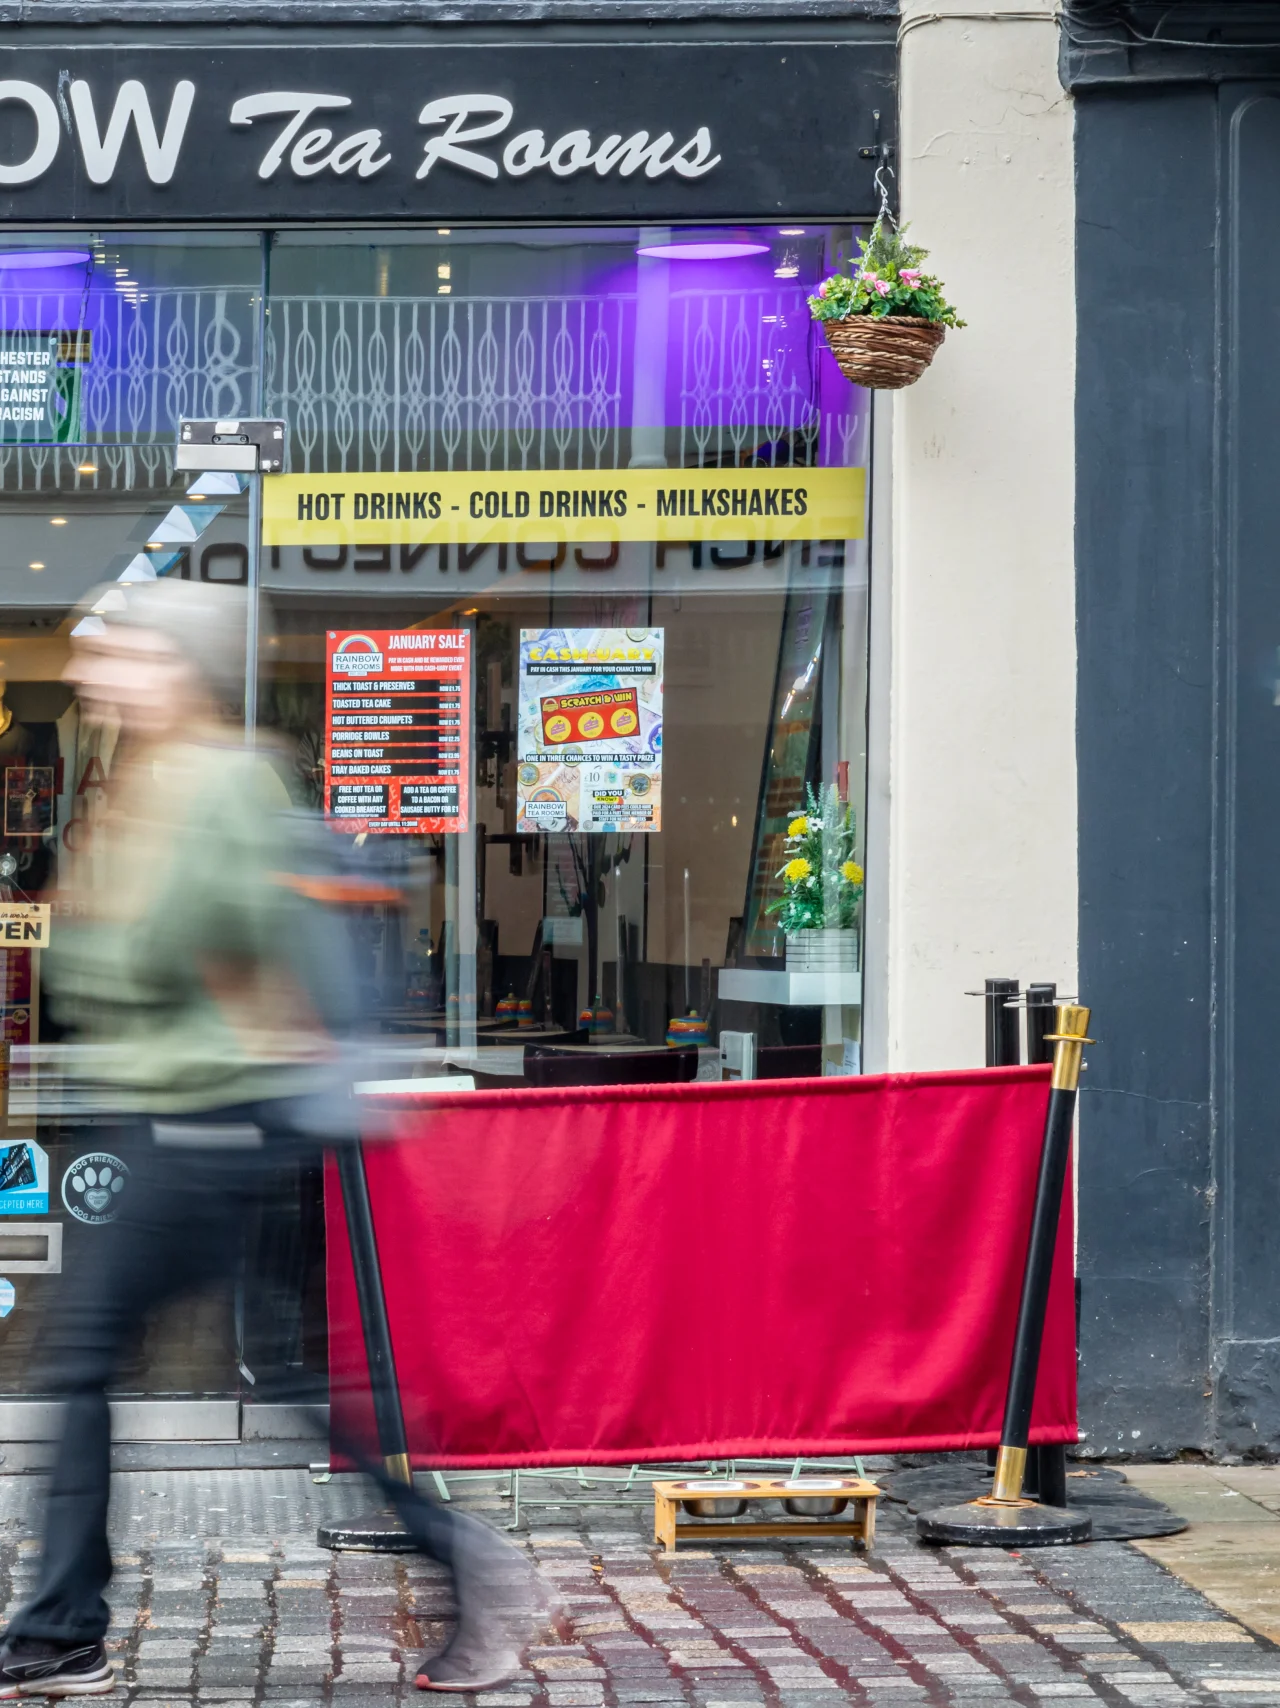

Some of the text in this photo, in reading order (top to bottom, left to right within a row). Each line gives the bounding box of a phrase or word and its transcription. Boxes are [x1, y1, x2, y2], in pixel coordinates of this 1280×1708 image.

[230, 91, 391, 178] Tea
[415, 94, 721, 179] Rooms
[298, 488, 808, 520] HOT DRINKS COLD DRINKS MILKSHAKES
[388, 635, 465, 650] JANUARY SALE
[336, 655, 380, 663] RAINBOW
[528, 648, 655, 661] CASH-UARY
[332, 681, 415, 691] THICK TOAST & PRESERVES
[332, 699, 391, 708] TOASTED TEA CAKE
[560, 692, 633, 708] SCRATCH & WIN
[332, 715, 413, 725] HOT BUTTERED CRUMPETS
[332, 732, 390, 741] PORRIDGE BOWLES
[331, 749, 384, 758] BEANS ON TOAST
[331, 765, 391, 775] TRAY BAKED CAKES
[70, 1156, 126, 1175] DOG FRIENDLY
[26, 1199, 44, 1209] HERE
[72, 1205, 89, 1220] DOG
